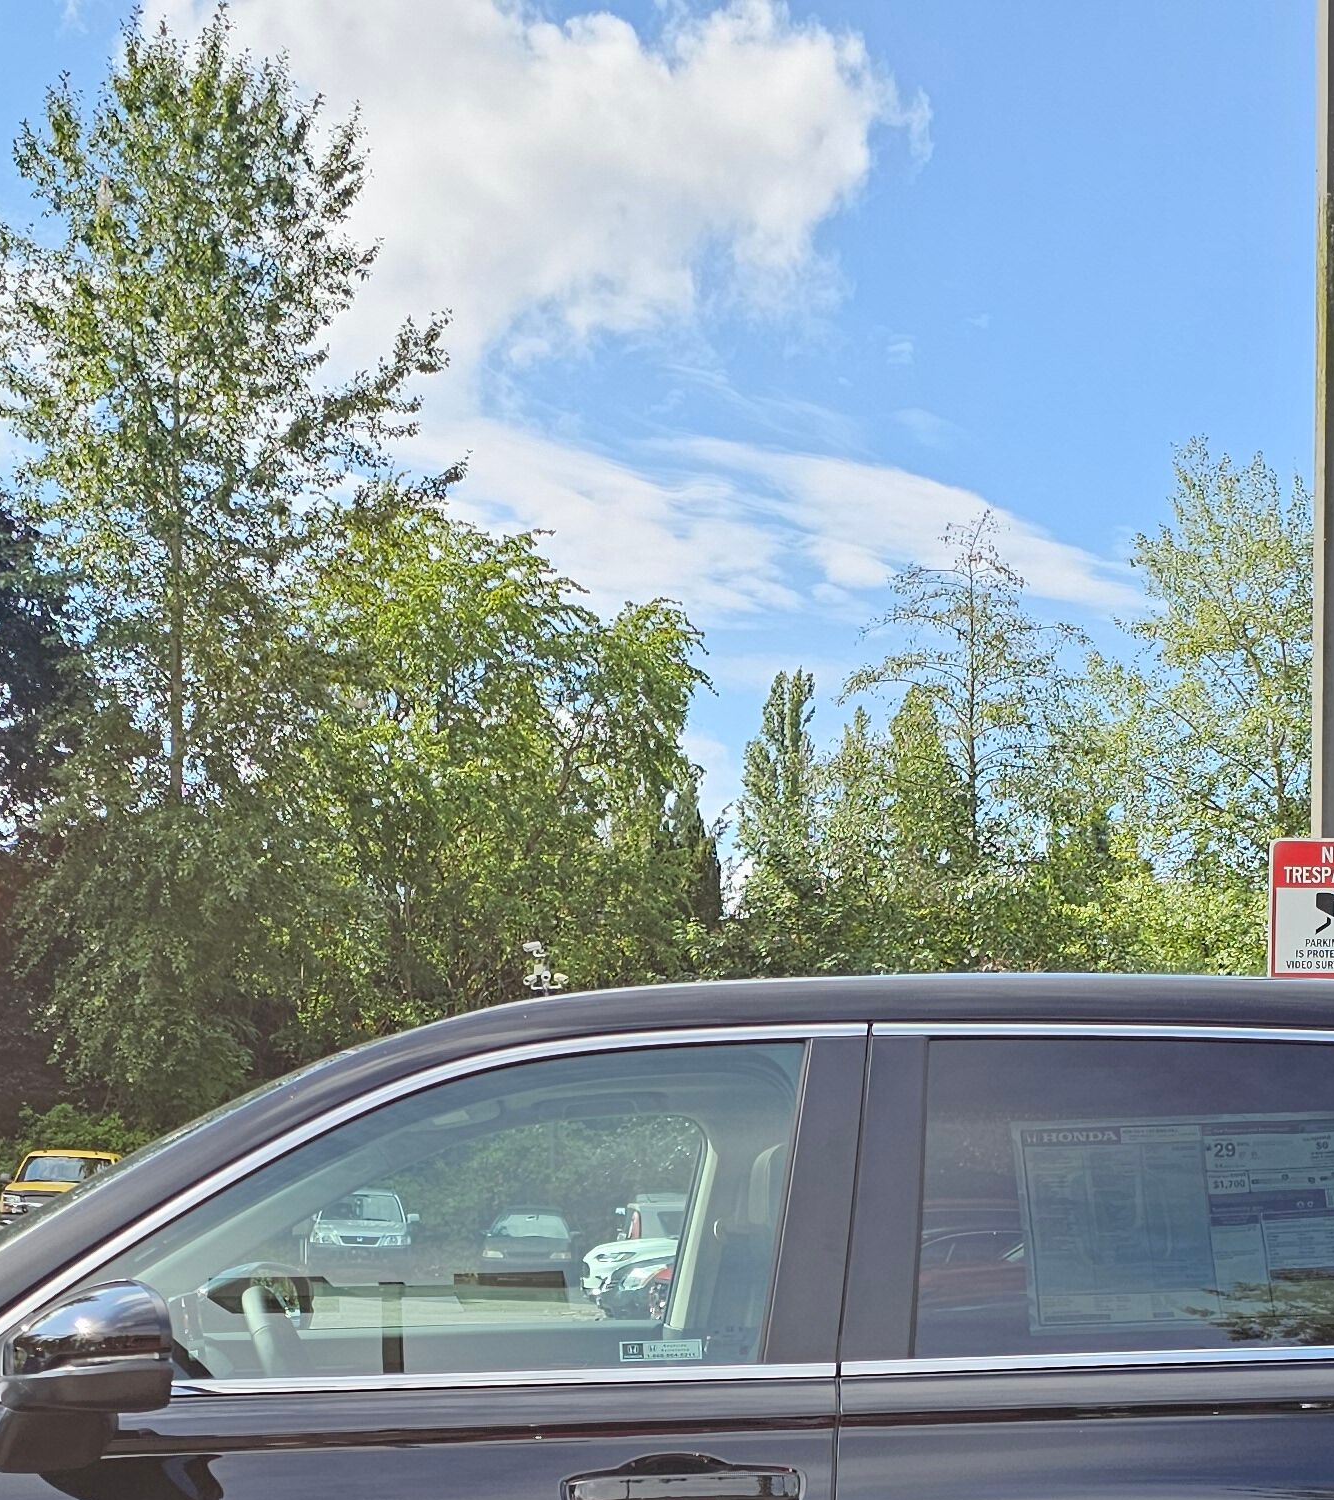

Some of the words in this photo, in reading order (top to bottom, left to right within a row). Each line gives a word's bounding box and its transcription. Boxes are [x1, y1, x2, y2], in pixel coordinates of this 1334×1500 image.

[1295, 949, 1305, 958] IS
[1286, 960, 1313, 969] VIDEO
[1041, 1129, 1119, 1144] HONDA
[1214, 1142, 1236, 1158] 29
[1213, 1178, 1246, 1190] $1,700
